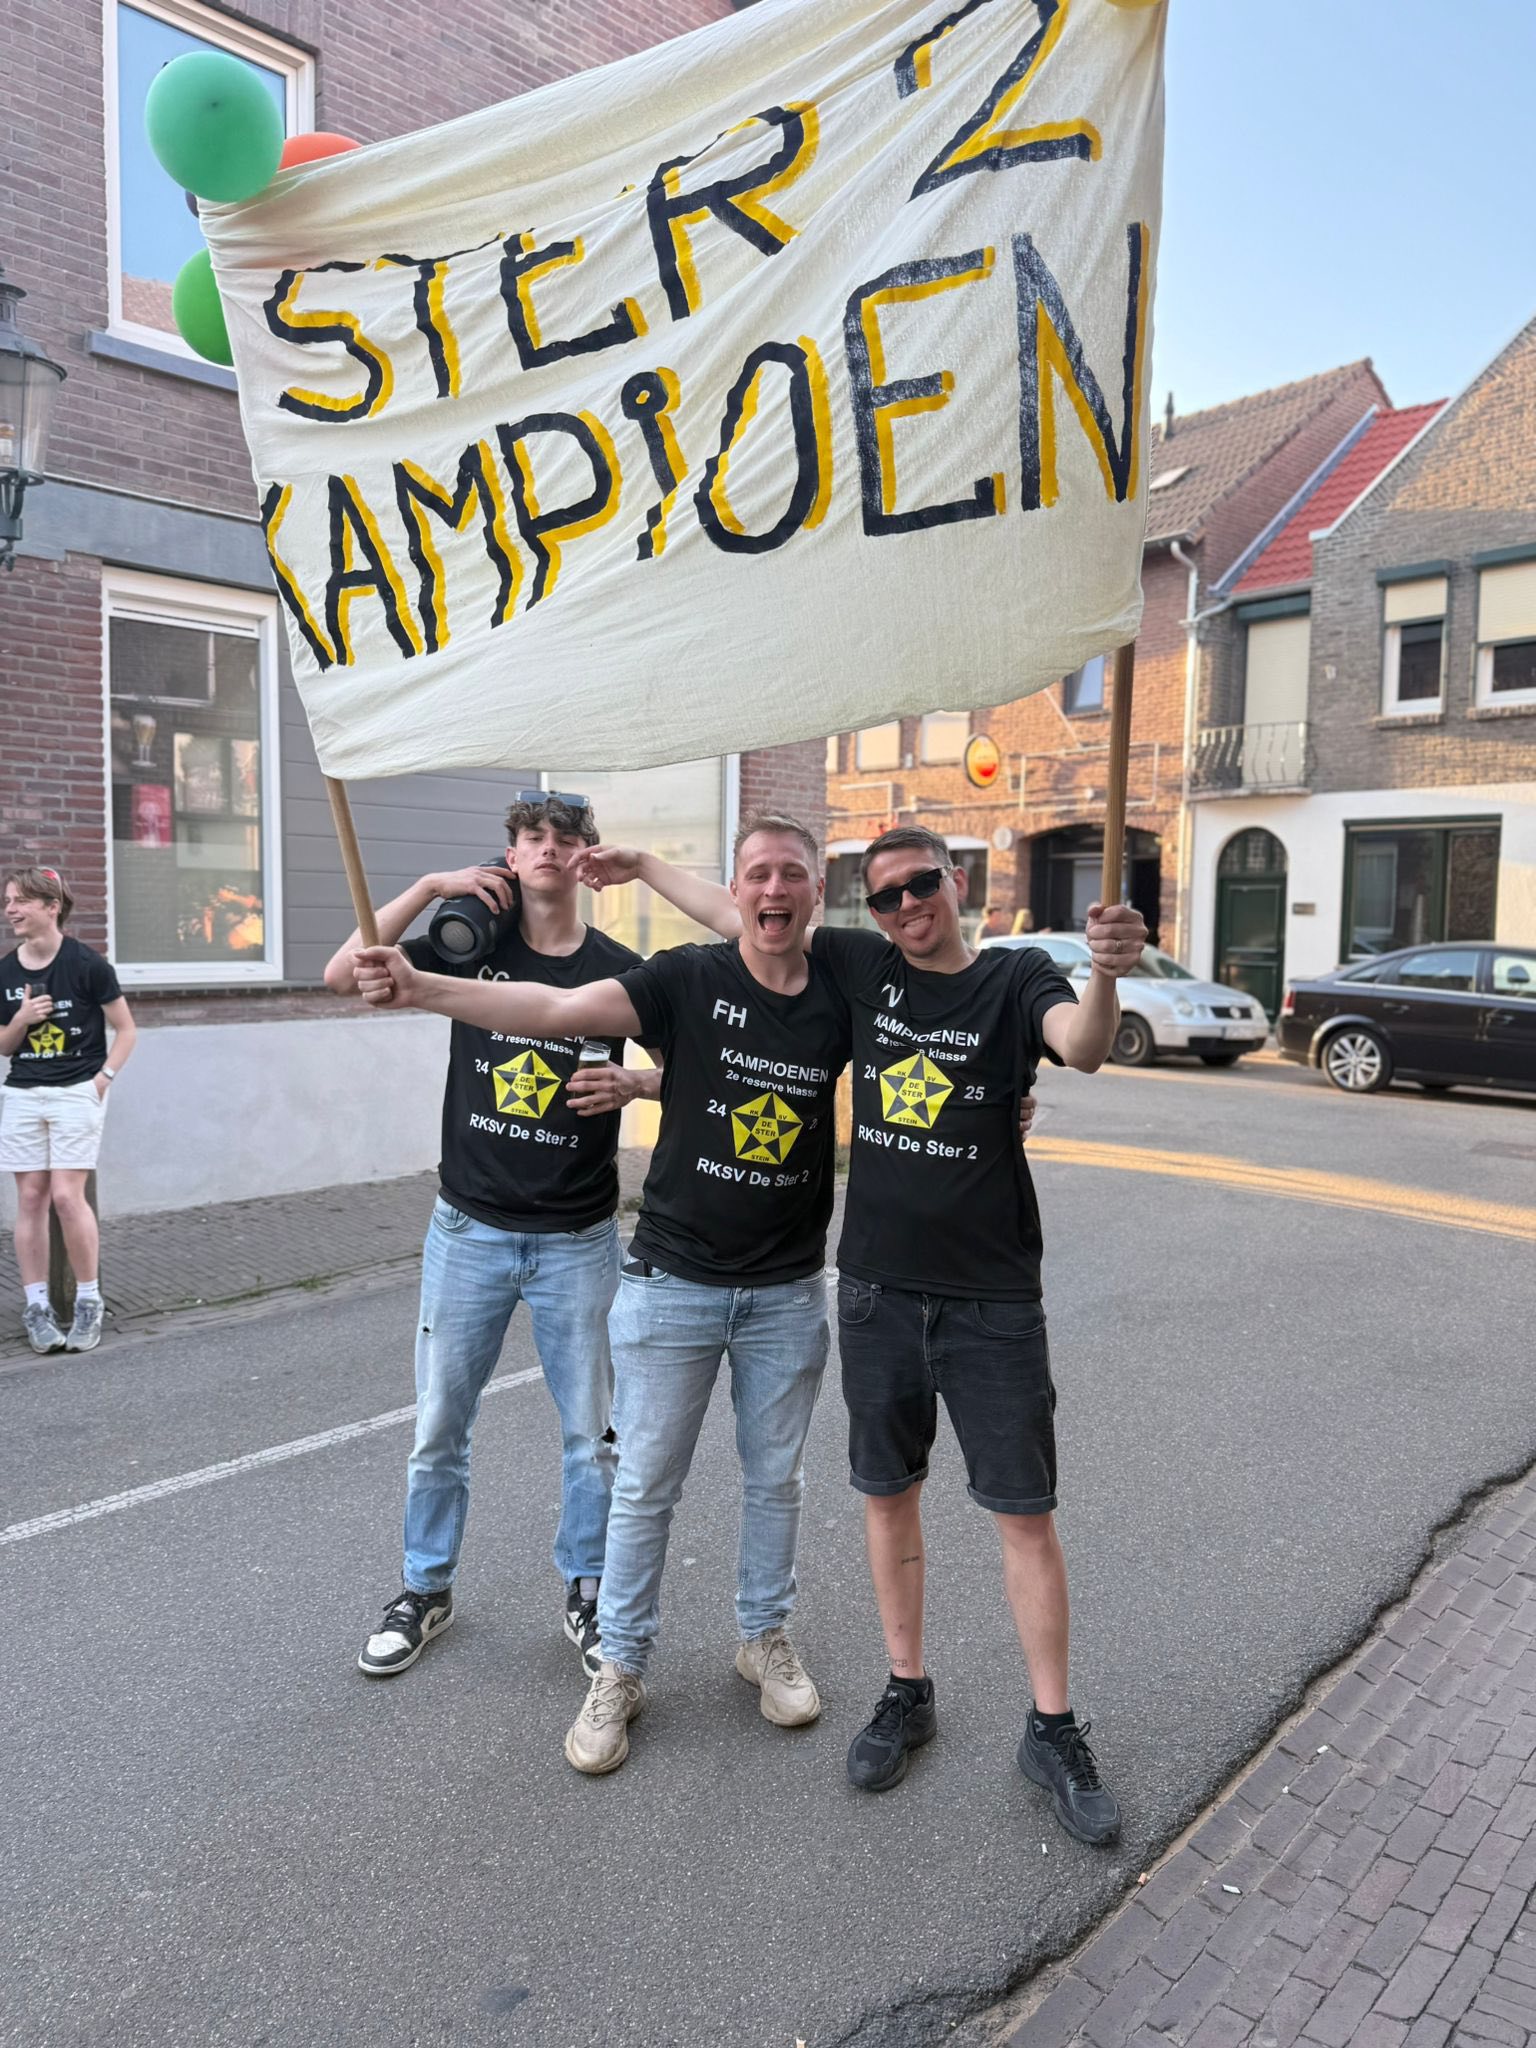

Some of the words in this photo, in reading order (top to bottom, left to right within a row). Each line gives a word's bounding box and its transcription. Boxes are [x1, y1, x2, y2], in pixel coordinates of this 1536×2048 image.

[263, 101, 818, 420] STER
[894, 0, 1102, 204] 2
[712, 998, 747, 1028] FH
[873, 1012, 980, 1047] KAMPIOENEN
[490, 1031, 504, 1041] 2e
[506, 1035, 542, 1048] reserve
[544, 1041, 575, 1056] klasse
[876, 1033, 889, 1045] 2e
[928, 1048, 967, 1062] klasse
[720, 1048, 829, 1083] KAMPIOENEN
[864, 1064, 877, 1081] 24
[514, 1083, 535, 1092] STER
[725, 1069, 740, 1081] 2e
[742, 1075, 784, 1093] reserve
[786, 1085, 818, 1098] klasse
[908, 1082, 920, 1090] DE
[901, 1090, 923, 1099] STER
[964, 1086, 985, 1101] 25
[706, 1099, 727, 1117] 24
[761, 1120, 773, 1128] DE
[898, 1116, 918, 1125] STEIN
[470, 1113, 507, 1135] RKSV
[509, 1125, 530, 1141] De
[534, 1128, 567, 1147] Ster
[569, 1135, 579, 1148] 2
[755, 1128, 777, 1137] STER
[858, 1124, 895, 1148] RKSV
[898, 1136, 921, 1152] De
[926, 1140, 964, 1158] Ster
[967, 1145, 978, 1160] 2
[751, 1154, 770, 1162] STEIN
[696, 1157, 746, 1183] RKSV
[749, 1172, 771, 1187] De
[774, 1172, 800, 1188] Ster
[801, 1169, 810, 1183] 2
